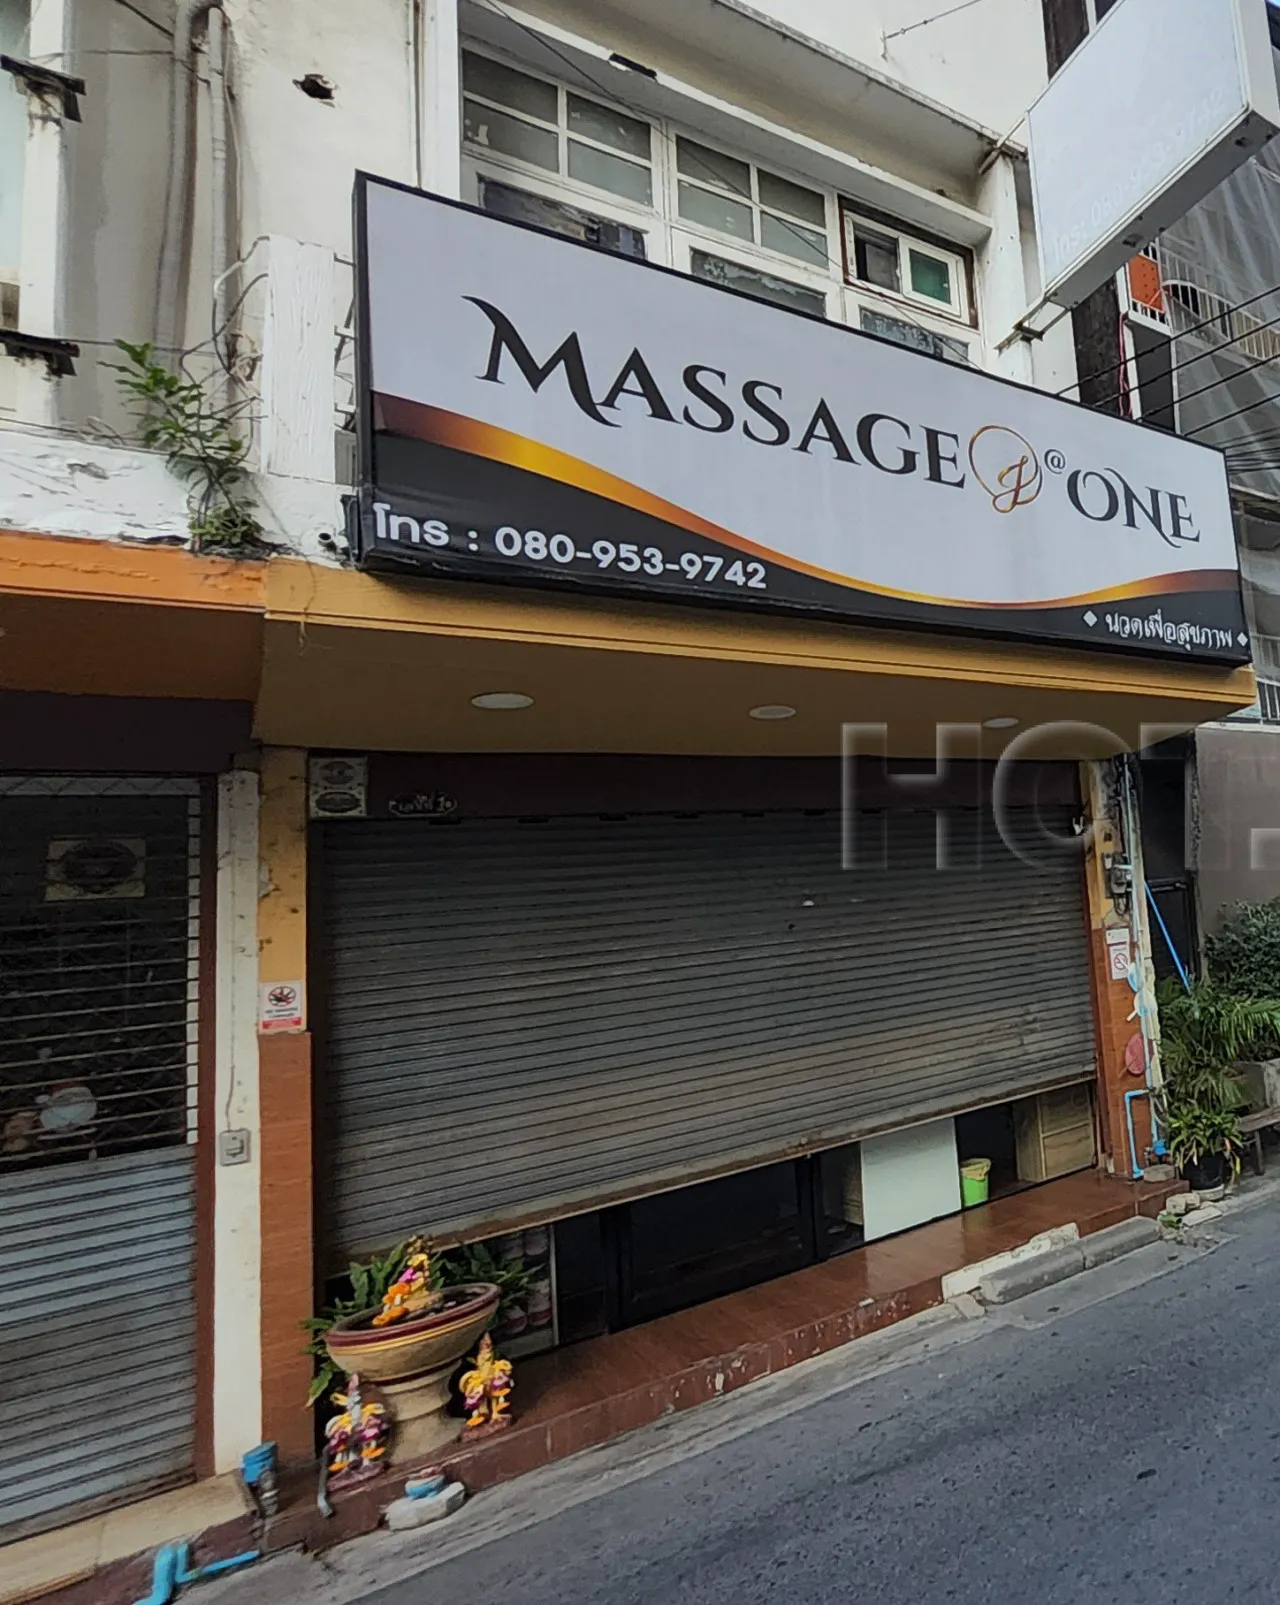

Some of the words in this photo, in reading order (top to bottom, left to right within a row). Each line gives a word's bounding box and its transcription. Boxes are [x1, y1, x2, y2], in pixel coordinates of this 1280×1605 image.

[460, 295, 966, 488] MASSAGE
[1044, 449, 1066, 474] @
[1066, 467, 1200, 548] ONE
[373, 502, 450, 547] โทร
[494, 526, 768, 588] 080-953-9742
[1105, 609, 1232, 651] นวดเพื่อสุขภาพ
